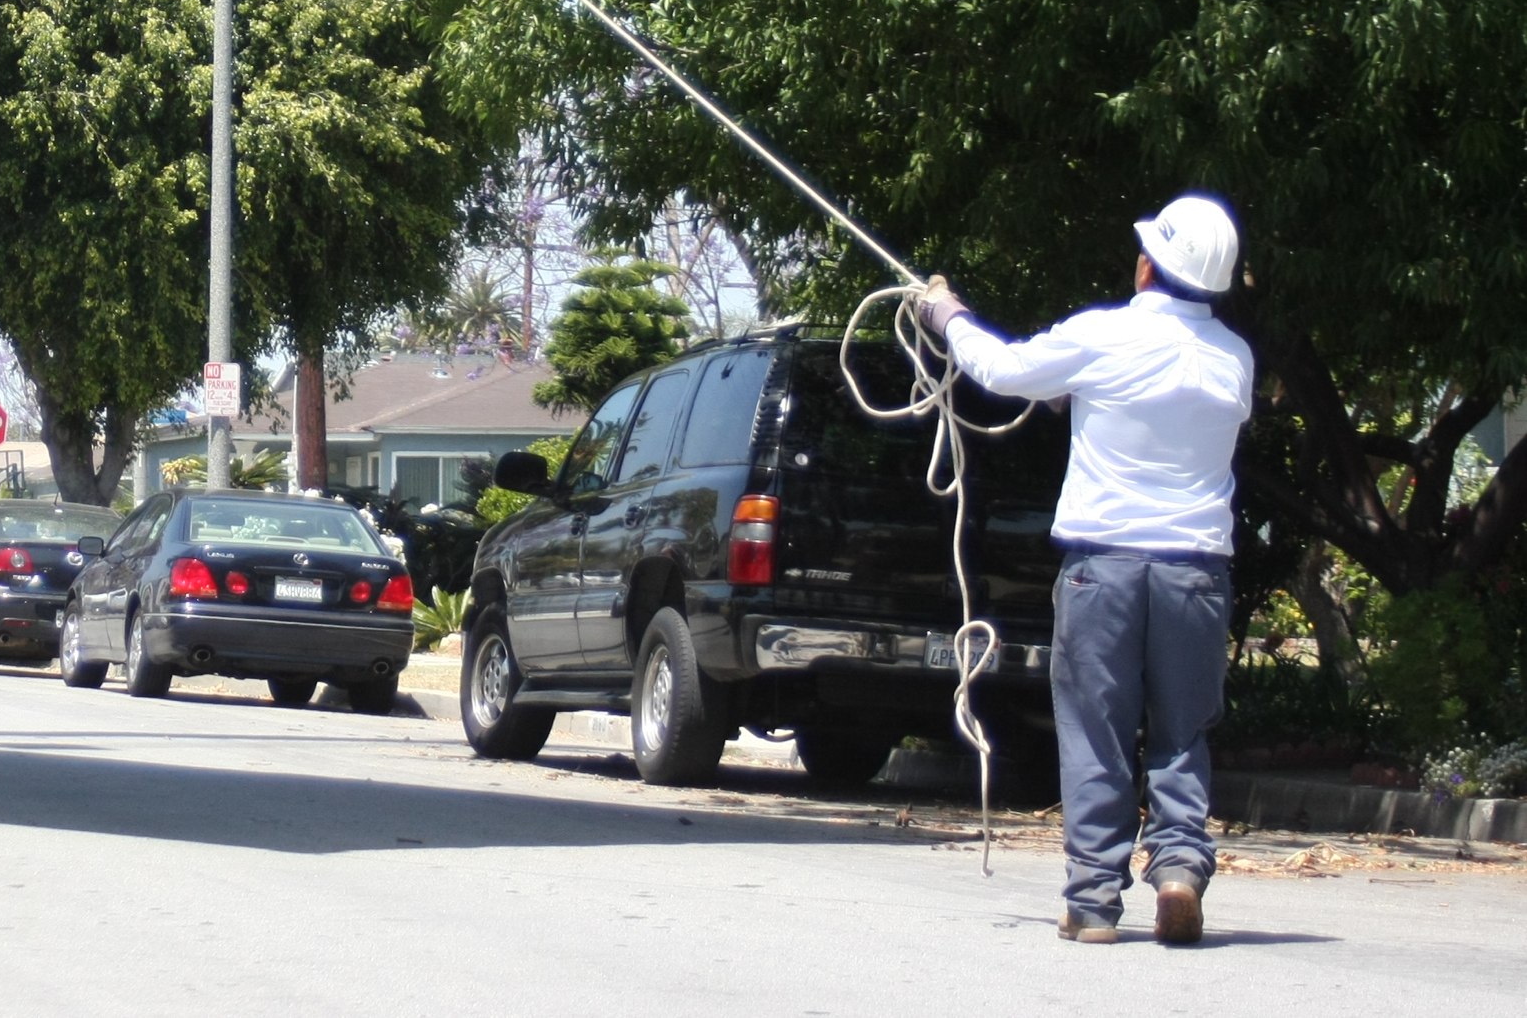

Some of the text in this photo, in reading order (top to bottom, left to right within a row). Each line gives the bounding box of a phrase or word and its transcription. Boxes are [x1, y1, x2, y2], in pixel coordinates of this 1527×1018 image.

[207, 365, 219, 377] NO
[207, 380, 237, 390] PARKING
[207, 390, 215, 400] 12
[805, 568, 852, 581] TAHOE
